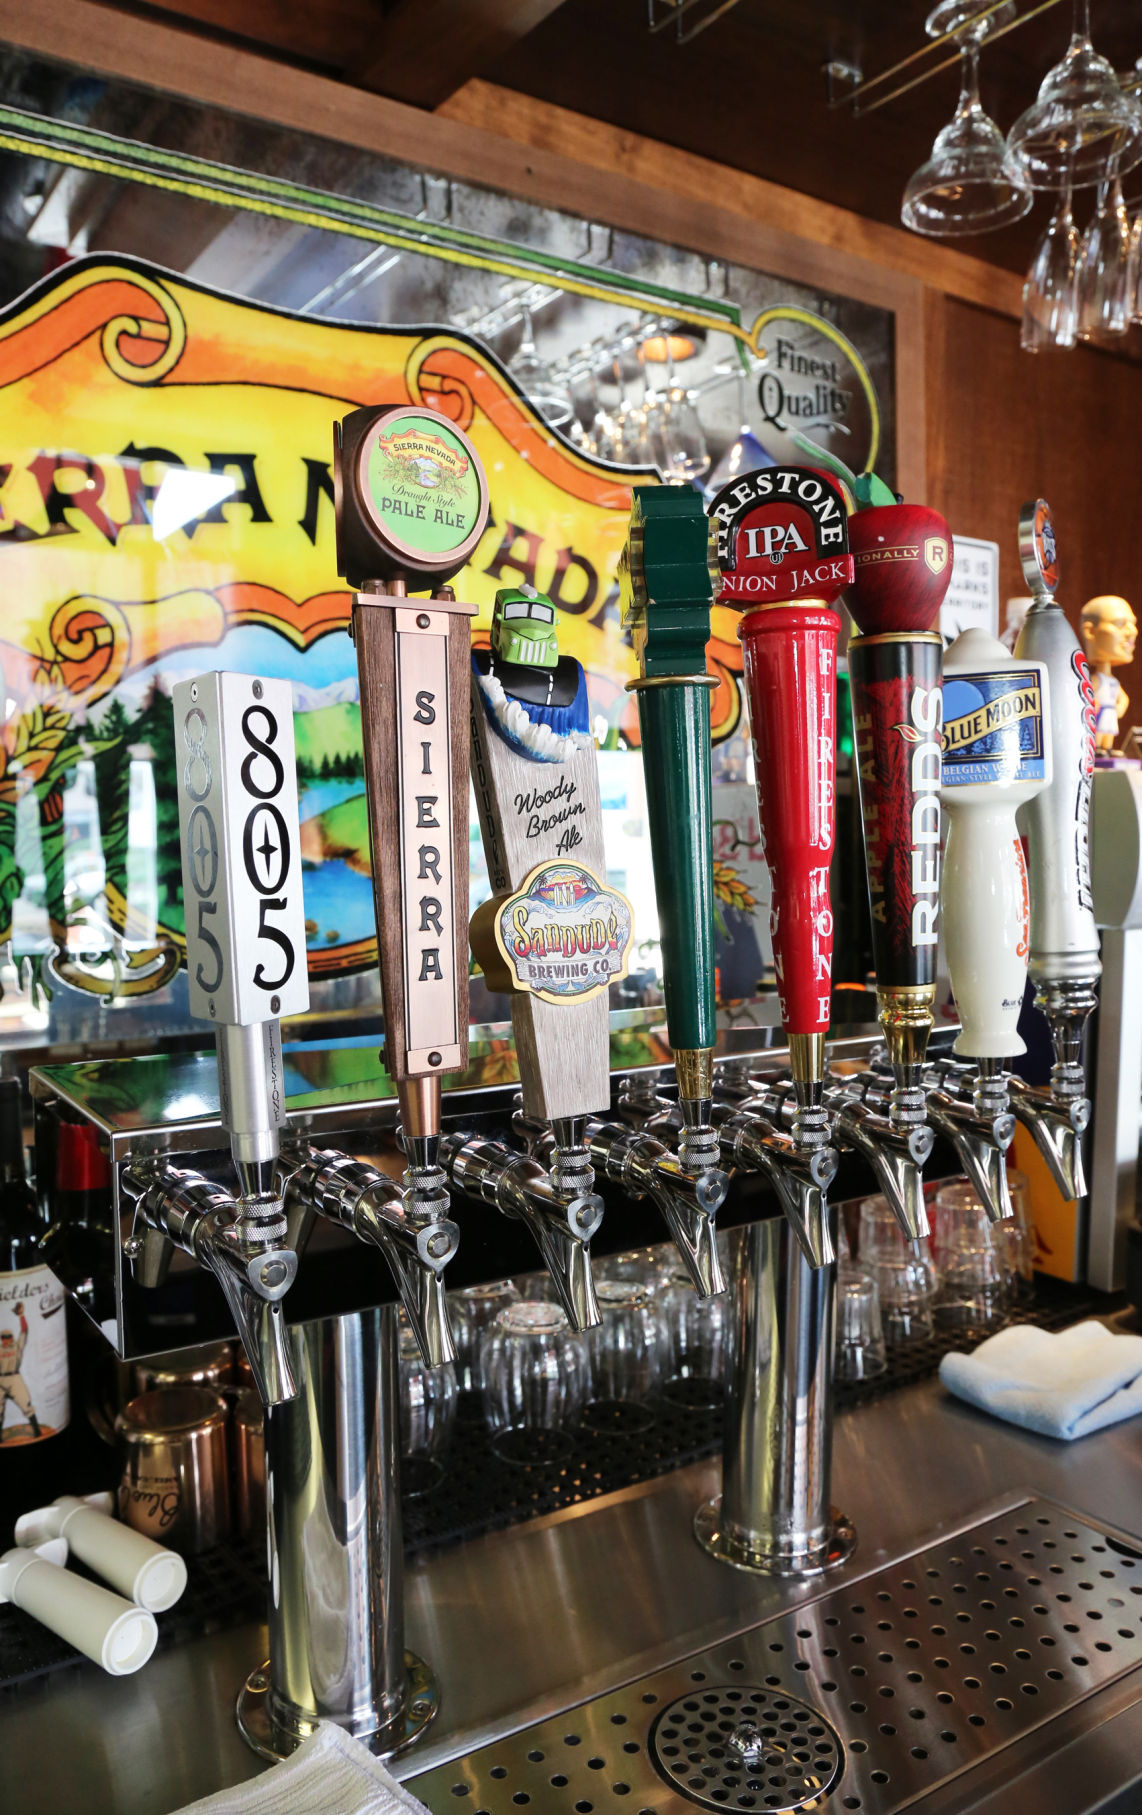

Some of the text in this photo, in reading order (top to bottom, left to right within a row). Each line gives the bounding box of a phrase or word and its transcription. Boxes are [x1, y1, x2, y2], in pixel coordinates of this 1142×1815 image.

[777, 339, 837, 383] Finest
[758, 373, 848, 431] Quality
[393, 442, 456, 466] SIERRA NEVADA
[0, 441, 273, 547] RRA
[381, 496, 466, 529] PALE ALE
[392, 484, 456, 508] Draught Style
[744, 522, 809, 559] IPA
[932, 545, 944, 562] R
[722, 561, 846, 592] NION JACK
[986, 692, 1036, 728] MOON
[943, 764, 988, 776] BELGIAN
[514, 775, 576, 815] Woody
[413, 690, 444, 981] SIERRA
[526, 801, 586, 838] Brown
[816, 649, 833, 1023] FIRESTONE
[855, 713, 887, 924] APPLE ALE
[184, 707, 224, 993] 805
[241, 705, 295, 991] 805
[556, 825, 582, 856] Ale
[528, 958, 613, 979] BREWING CO.
[269, 1025, 280, 1122] FIRESTONE
[0, 1282, 49, 1301] ielders
